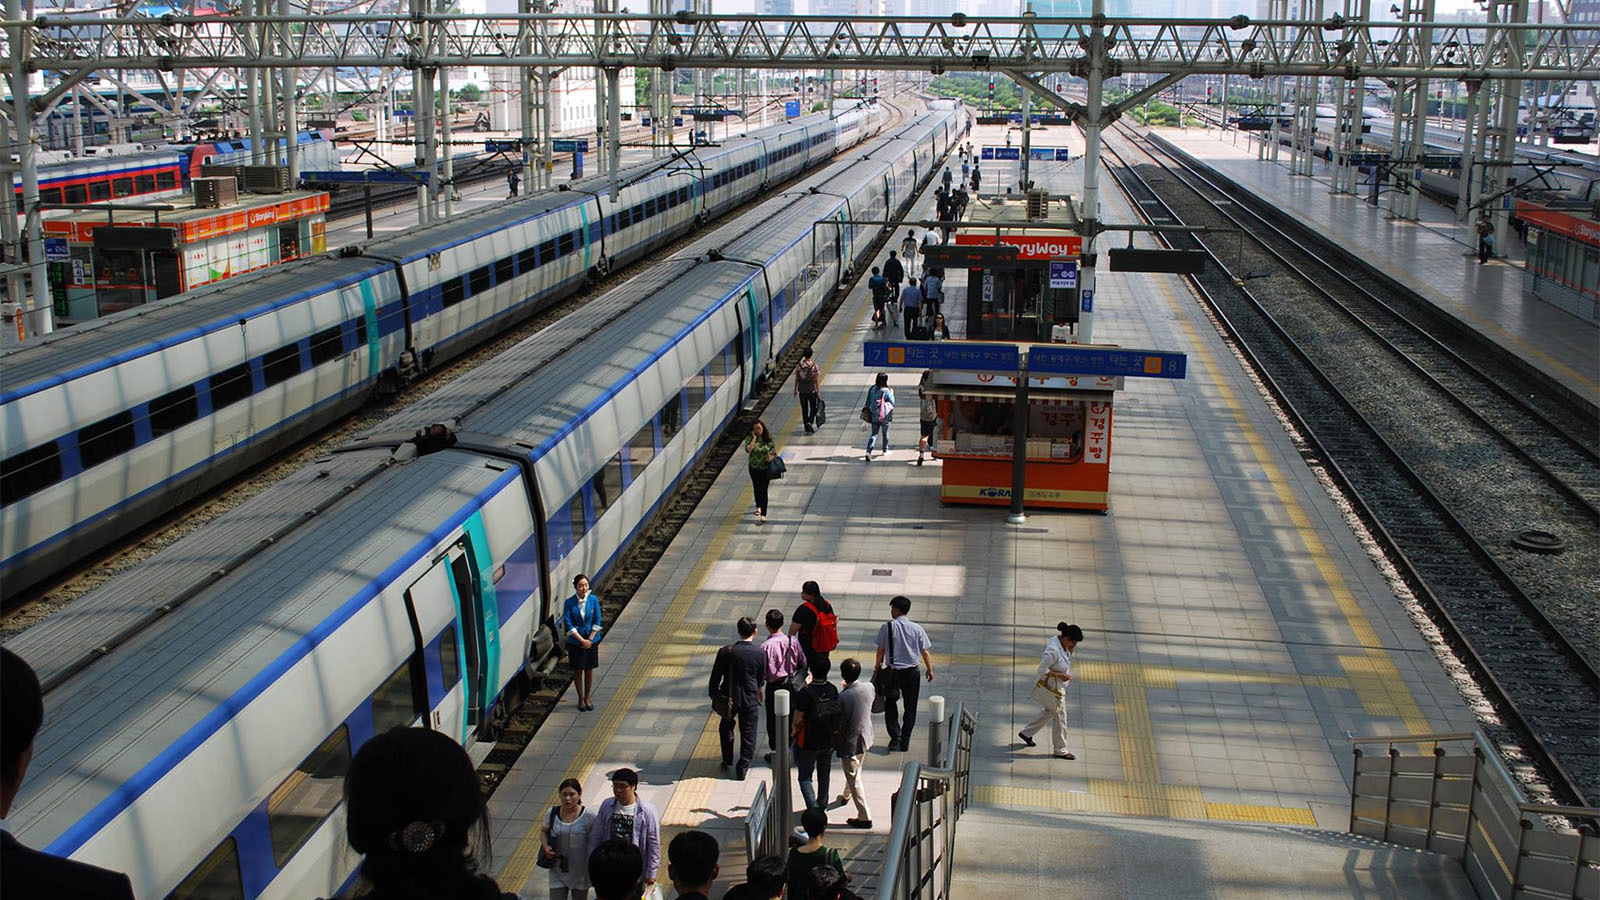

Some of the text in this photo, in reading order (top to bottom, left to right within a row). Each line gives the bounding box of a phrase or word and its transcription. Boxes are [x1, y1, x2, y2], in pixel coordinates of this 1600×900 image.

[872, 349, 881, 361] 7
[929, 347, 939, 359] 곳
[1133, 355, 1143, 368] 곳
[1168, 359, 1177, 372] 8
[1041, 411, 1081, 427] 경주
